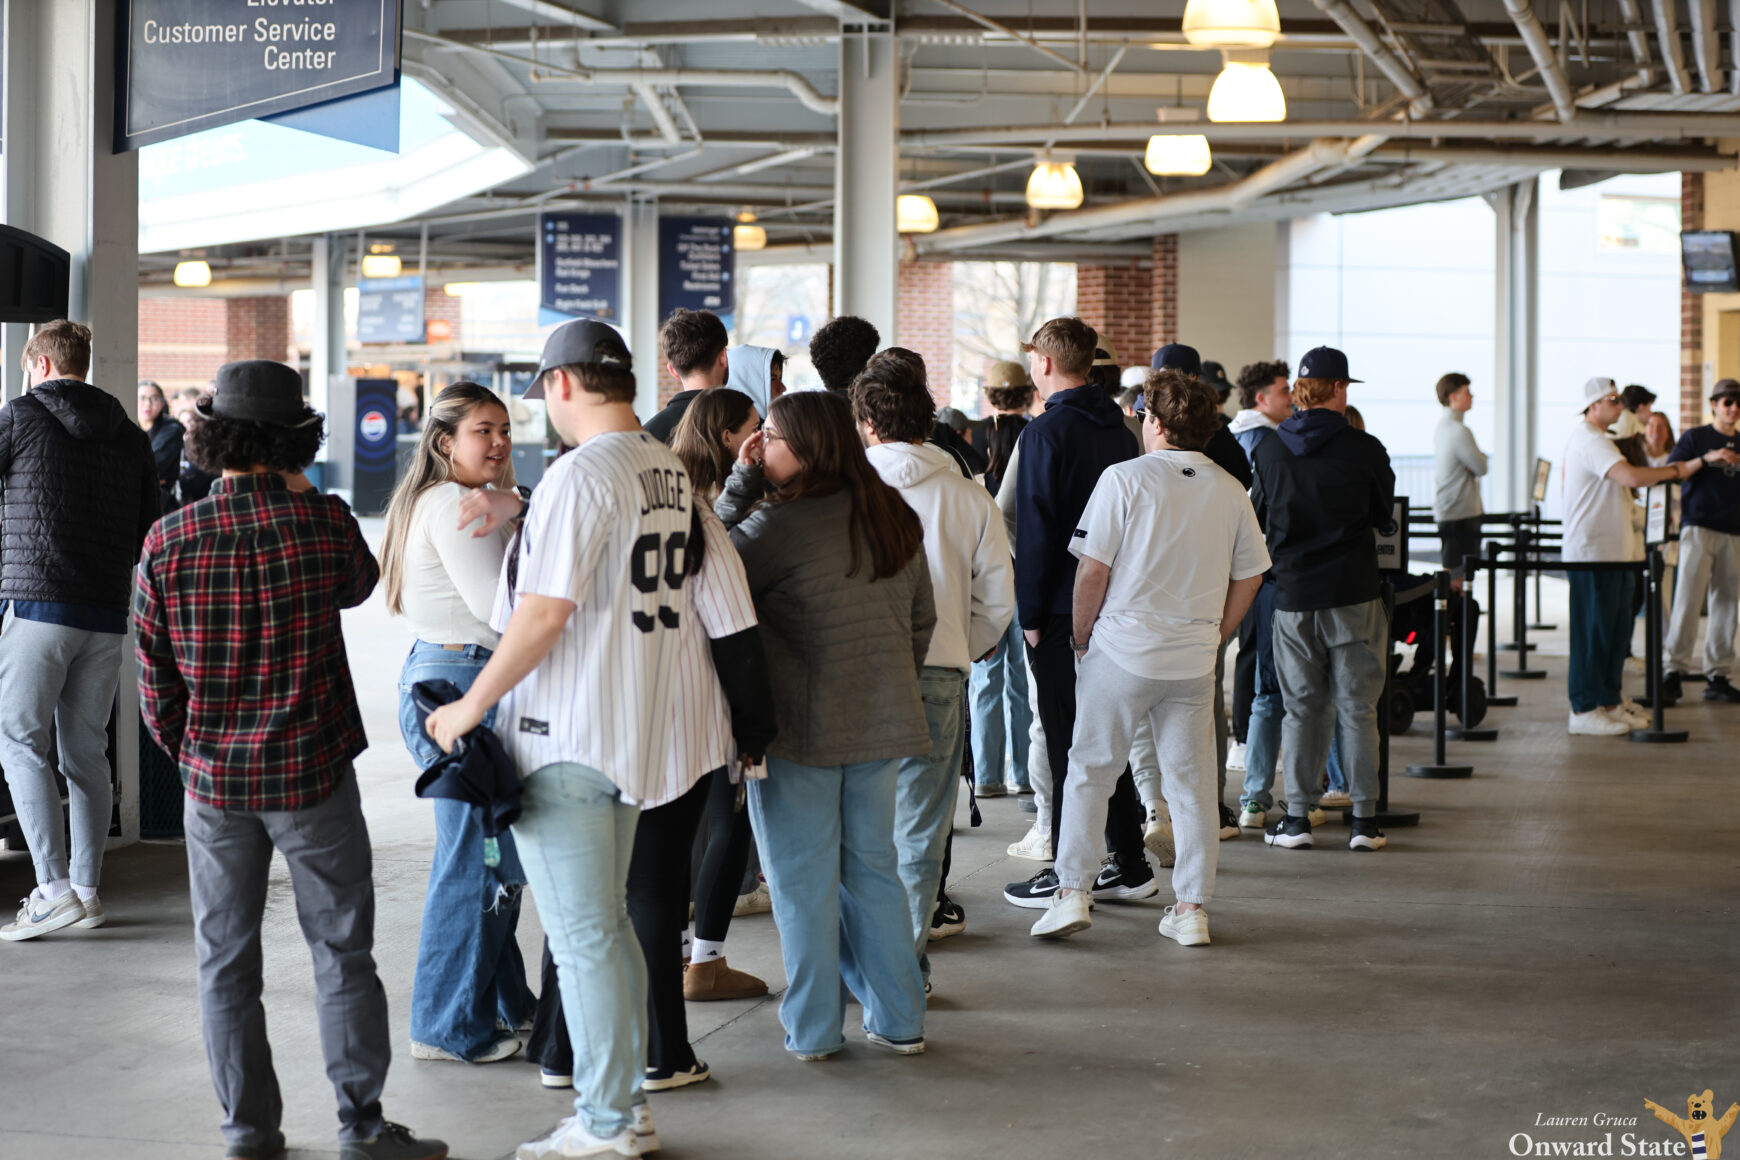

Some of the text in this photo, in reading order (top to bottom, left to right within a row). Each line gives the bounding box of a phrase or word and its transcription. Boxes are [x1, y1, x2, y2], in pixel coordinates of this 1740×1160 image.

[143, 17, 336, 44] Customer Service
[264, 46, 336, 70] Center
[638, 467, 686, 516] JUDGE
